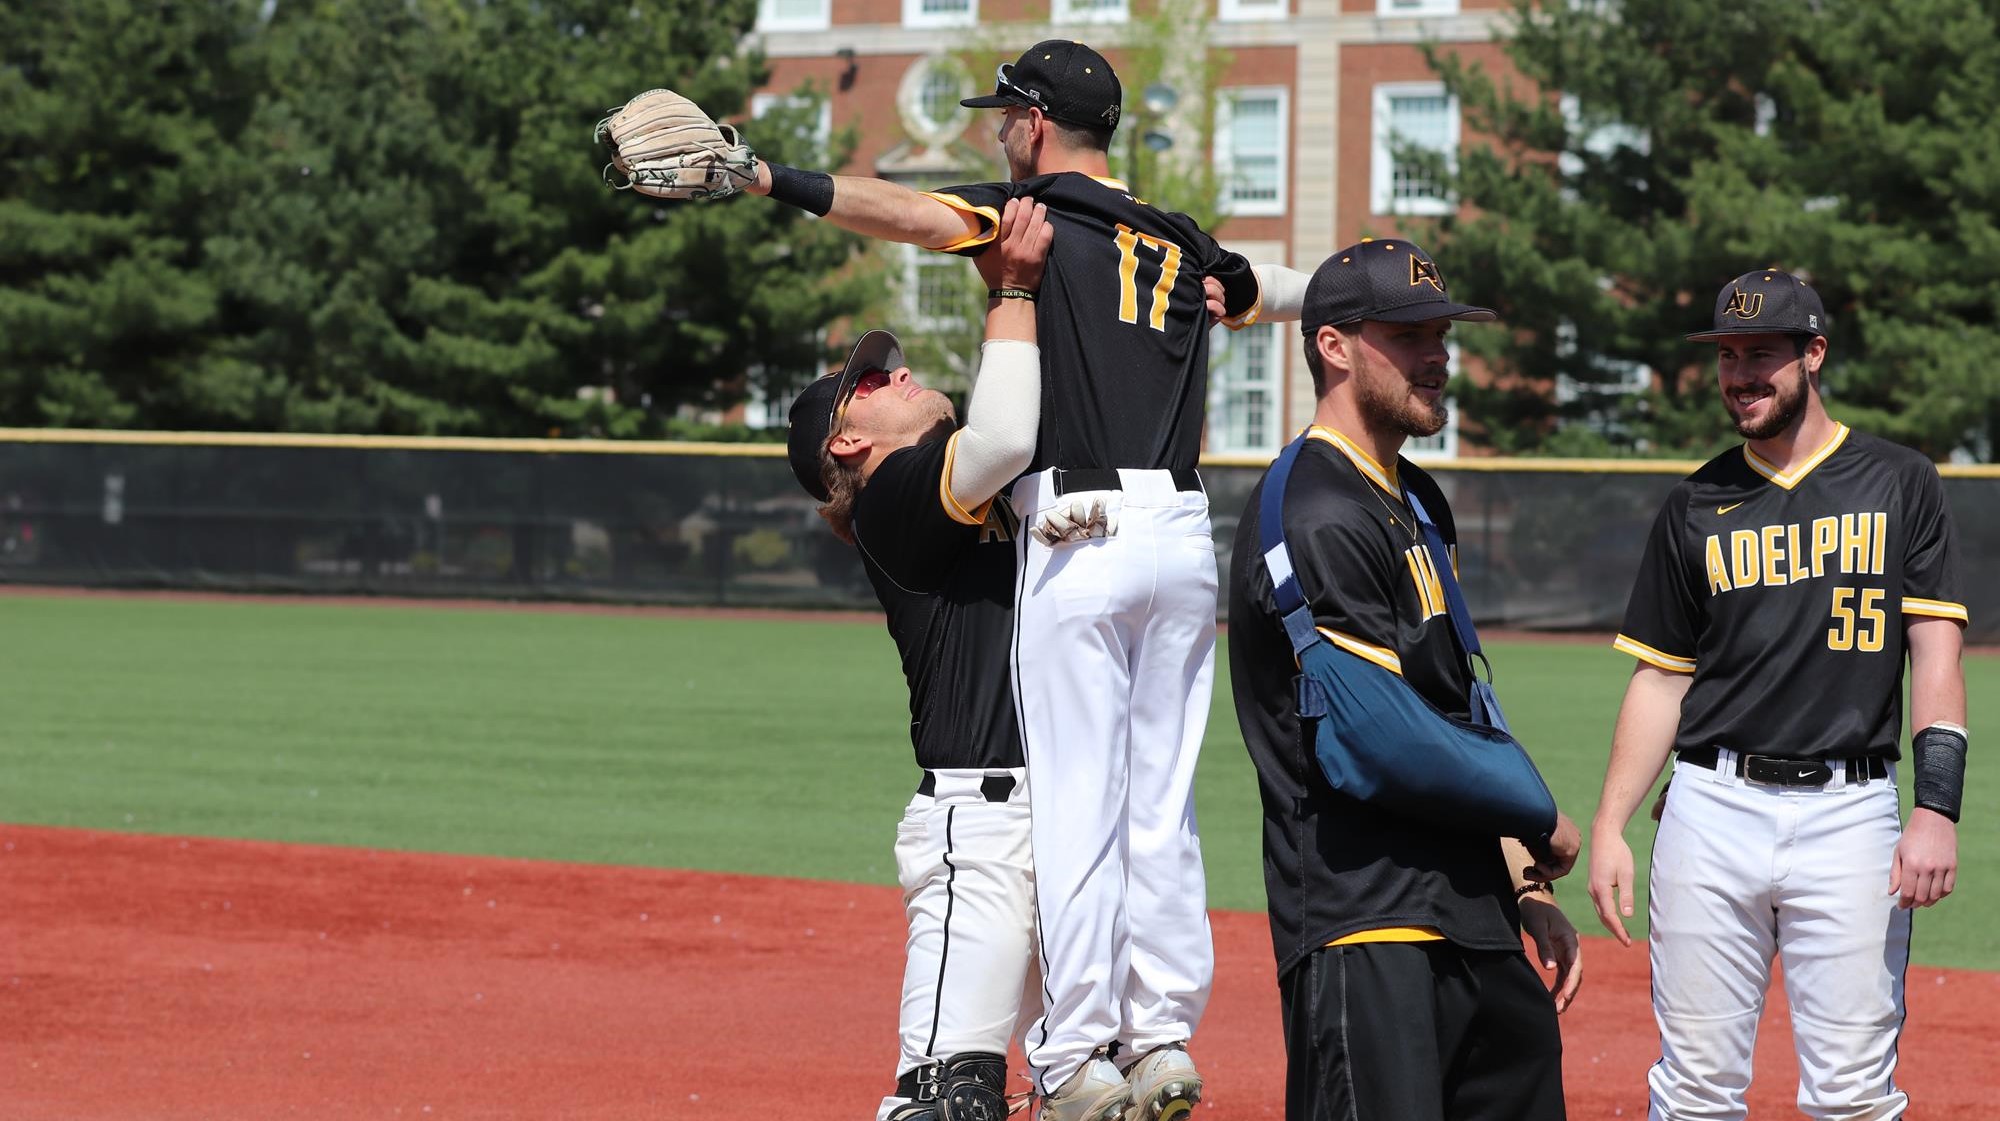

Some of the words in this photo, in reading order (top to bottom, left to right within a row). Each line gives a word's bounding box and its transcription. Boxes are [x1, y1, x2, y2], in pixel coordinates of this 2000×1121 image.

[1113, 223, 1183, 333] 17
[1722, 287, 1764, 320] AU
[1705, 512, 1888, 597] ADELPHI
[1827, 587, 1886, 652] 55
